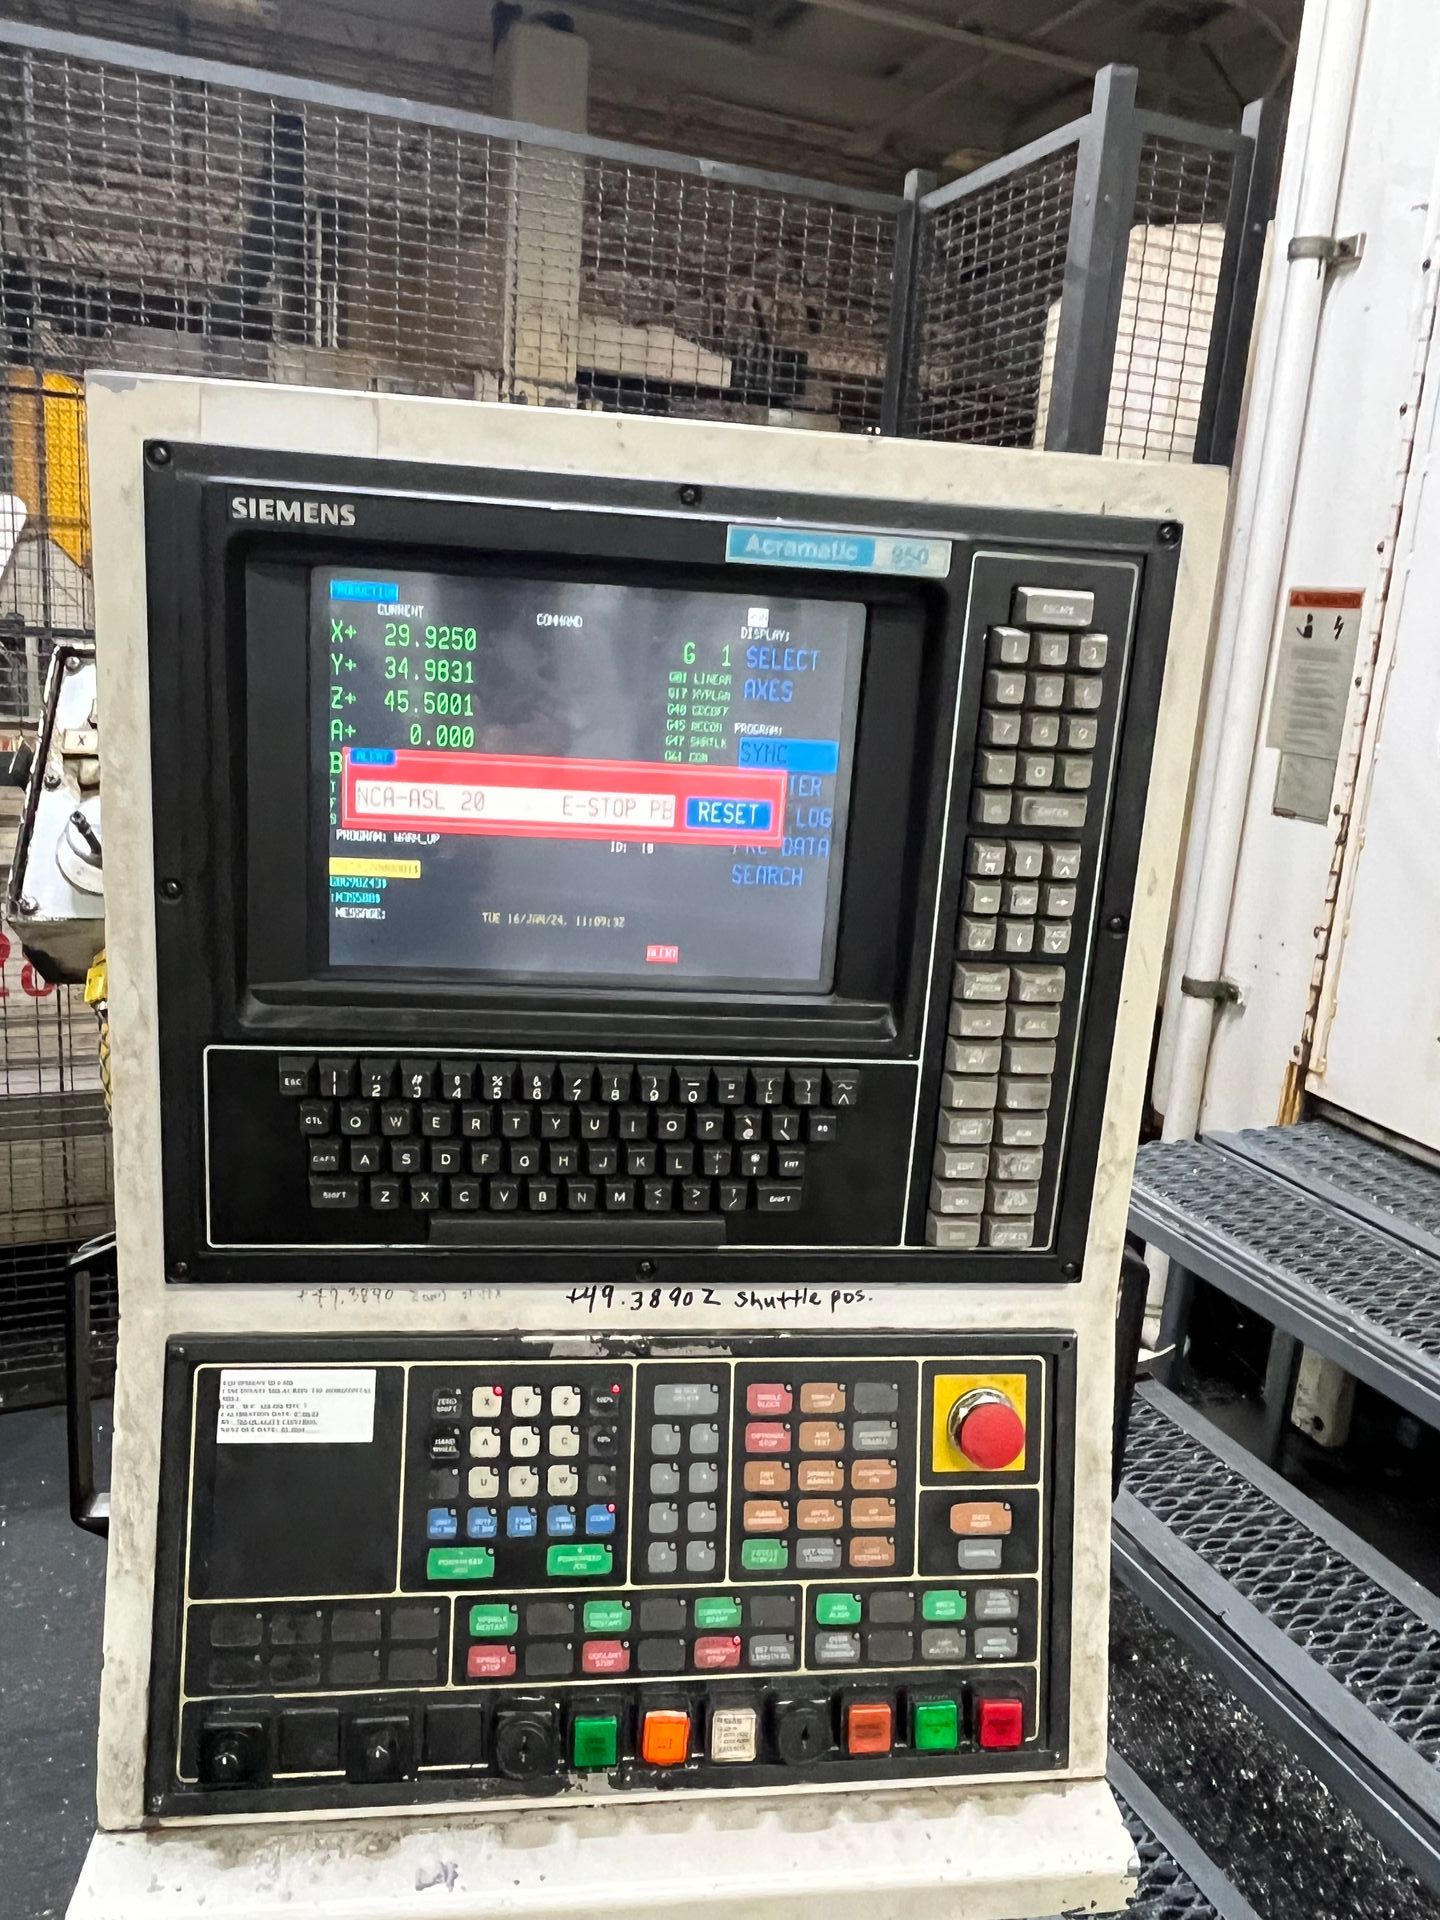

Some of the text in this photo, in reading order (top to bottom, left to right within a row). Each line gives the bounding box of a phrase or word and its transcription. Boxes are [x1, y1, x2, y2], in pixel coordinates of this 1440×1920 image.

[232, 497, 356, 526] SIEMENS
[745, 533, 858, 561] Acramatic
[331, 619, 476, 651] X+ 29.9250
[746, 645, 822, 671] SELECT
[331, 653, 474, 683] Y+ 34.9831
[744, 678, 793, 702] AXES
[331, 686, 473, 716] Z+ 45.5001
[330, 719, 474, 748] A+ 0.000
[357, 786, 759, 825] NCA-ASL 20 E-STOP PB RESET
[796, 807, 832, 827] LOG
[782, 837, 830, 857] DATA
[731, 864, 803, 887] SEARCH
[372, 1085, 381, 1097] 2
[413, 1087, 421, 1098] 3
[452, 1088, 461, 1098] 4
[493, 1087, 501, 1099] 5
[533, 1089, 541, 1099] 6
[572, 1089, 581, 1100] 7
[611, 1090, 619, 1100] 8
[650, 1090, 659, 1101] 9
[390, 1117, 402, 1127] W
[432, 1117, 440, 1128] E
[472, 1119, 480, 1129] R
[512, 1118, 520, 1129] T
[552, 1118, 560, 1129] Y
[590, 1120, 599, 1130] U
[706, 1121, 714, 1131] P
[360, 1155, 370, 1165] A
[402, 1154, 411, 1165] S
[441, 1154, 451, 1165] D
[482, 1154, 489, 1164] F
[559, 1156, 568, 1166] H
[599, 1157, 607, 1167] J
[637, 1157, 645, 1167] K
[675, 1158, 682, 1168] L
[381, 1191, 390, 1202] Z
[420, 1192, 430, 1202] X
[460, 1192, 469, 1202] C
[500, 1191, 509, 1202] V
[539, 1192, 547, 1202] B
[578, 1193, 586, 1202] N
[614, 1192, 625, 1202] M
[734, 1287, 822, 1310] shuttle
[831, 1290, 873, 1313] pos.
[484, 1398, 490, 1406] X
[482, 1438, 488, 1446] A
